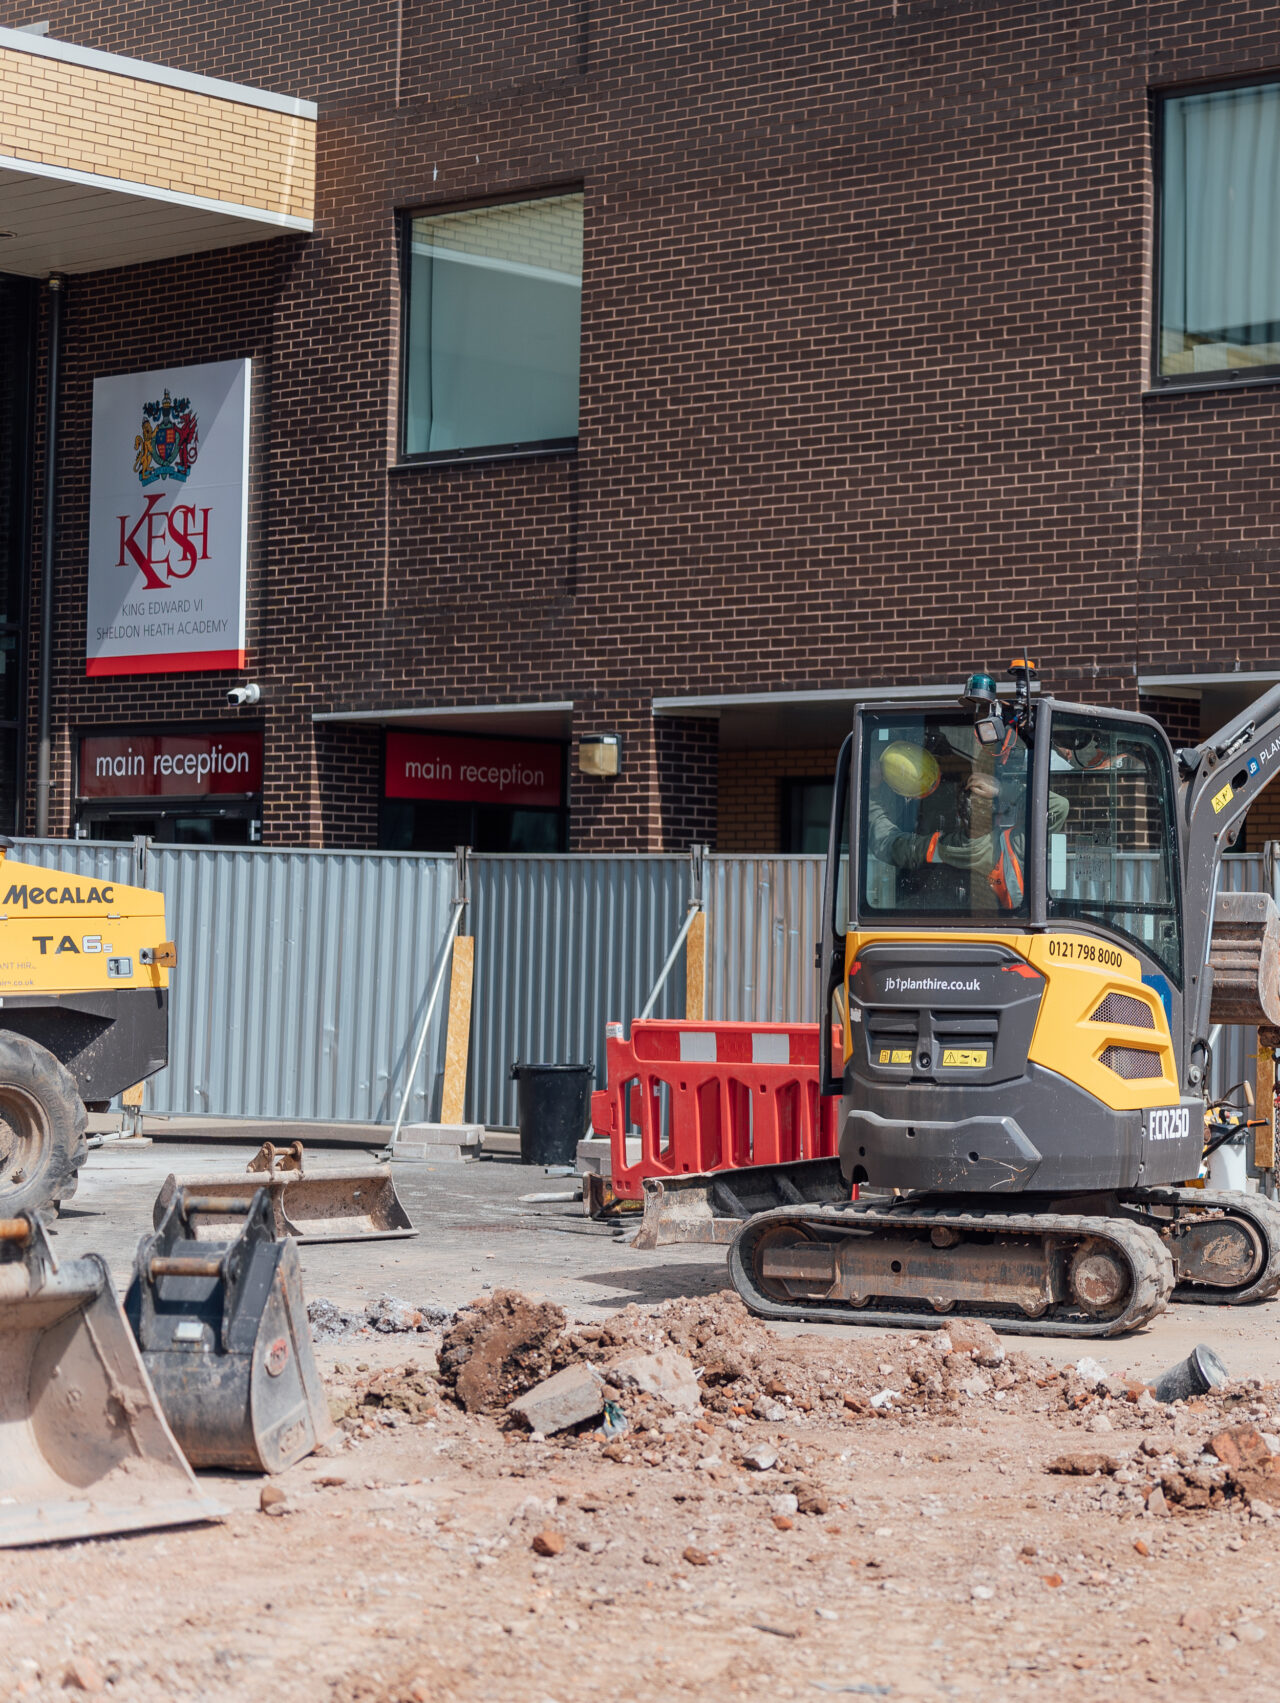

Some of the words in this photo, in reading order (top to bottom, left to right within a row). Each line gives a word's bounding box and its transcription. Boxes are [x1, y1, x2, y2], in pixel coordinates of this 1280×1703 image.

[115, 493, 213, 590] KESH
[122, 602, 145, 617] KING
[148, 600, 191, 615] EDWARD
[193, 599, 203, 612] VI
[96, 624, 140, 640] SHELDON
[143, 622, 175, 637] HEATH
[177, 619, 229, 635] ACADEMY
[96, 747, 145, 777] main
[153, 744, 249, 784] reception
[405, 757, 452, 780] main
[460, 763, 545, 791] reception
[1049, 940, 1074, 958] 0121
[1077, 944, 1096, 961] 798
[1098, 948, 1122, 968] 8000
[885, 977, 981, 992] jb1planthire.co.uk
